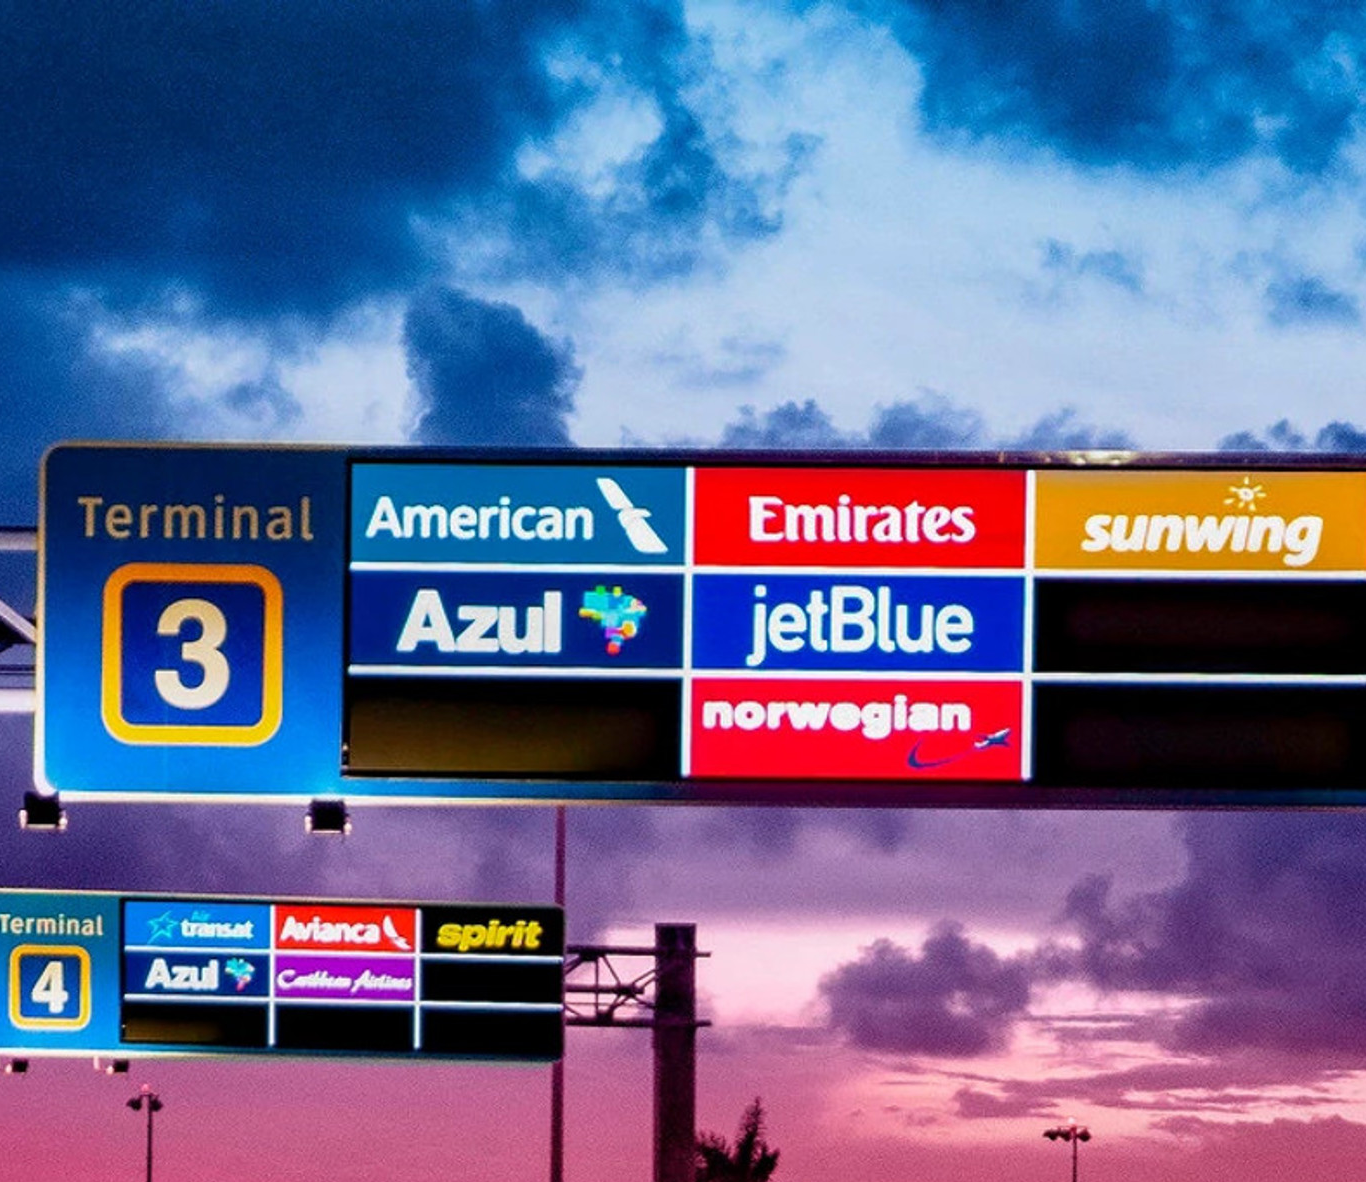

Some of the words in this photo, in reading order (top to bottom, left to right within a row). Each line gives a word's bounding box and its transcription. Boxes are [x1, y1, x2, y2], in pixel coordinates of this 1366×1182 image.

[77, 495, 314, 542] Terminal
[365, 496, 593, 541] American
[748, 495, 976, 545] Emirates
[1081, 512, 1323, 566] sunwing
[396, 589, 562, 653] Azul
[746, 585, 974, 666] jetBlue
[154, 598, 231, 710] 3
[702, 695, 971, 740] norwegian
[180, 918, 254, 940] transat
[279, 915, 380, 944] Avianca
[436, 919, 542, 950] spirit
[31, 960, 69, 1014] 4
[145, 957, 218, 990] Azul
